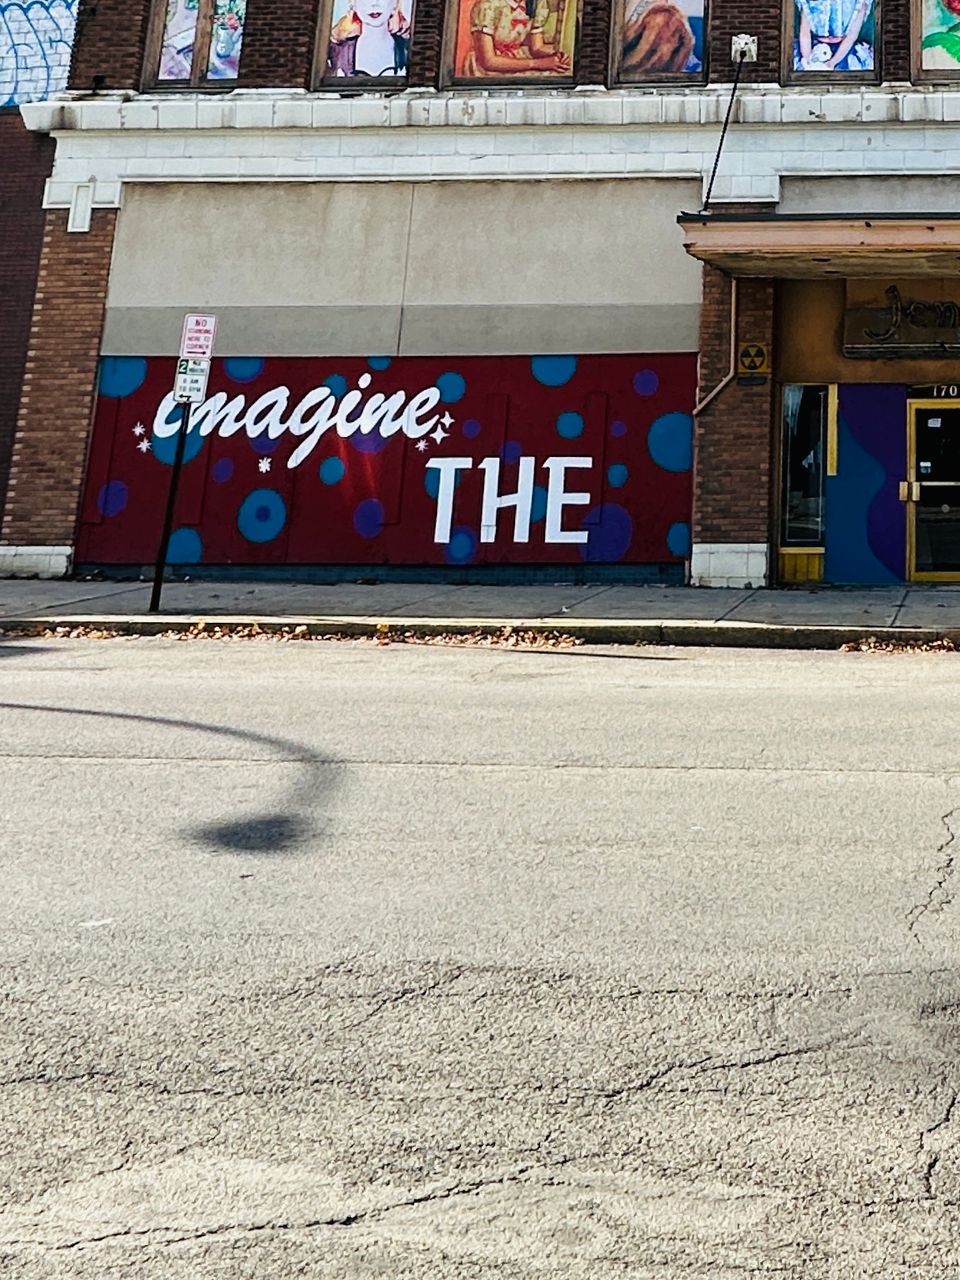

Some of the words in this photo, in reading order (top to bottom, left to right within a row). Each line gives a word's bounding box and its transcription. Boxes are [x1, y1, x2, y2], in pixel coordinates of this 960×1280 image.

[195, 319, 208, 328] NO
[179, 361, 188, 373] 2
[425, 456, 593, 544] THE
